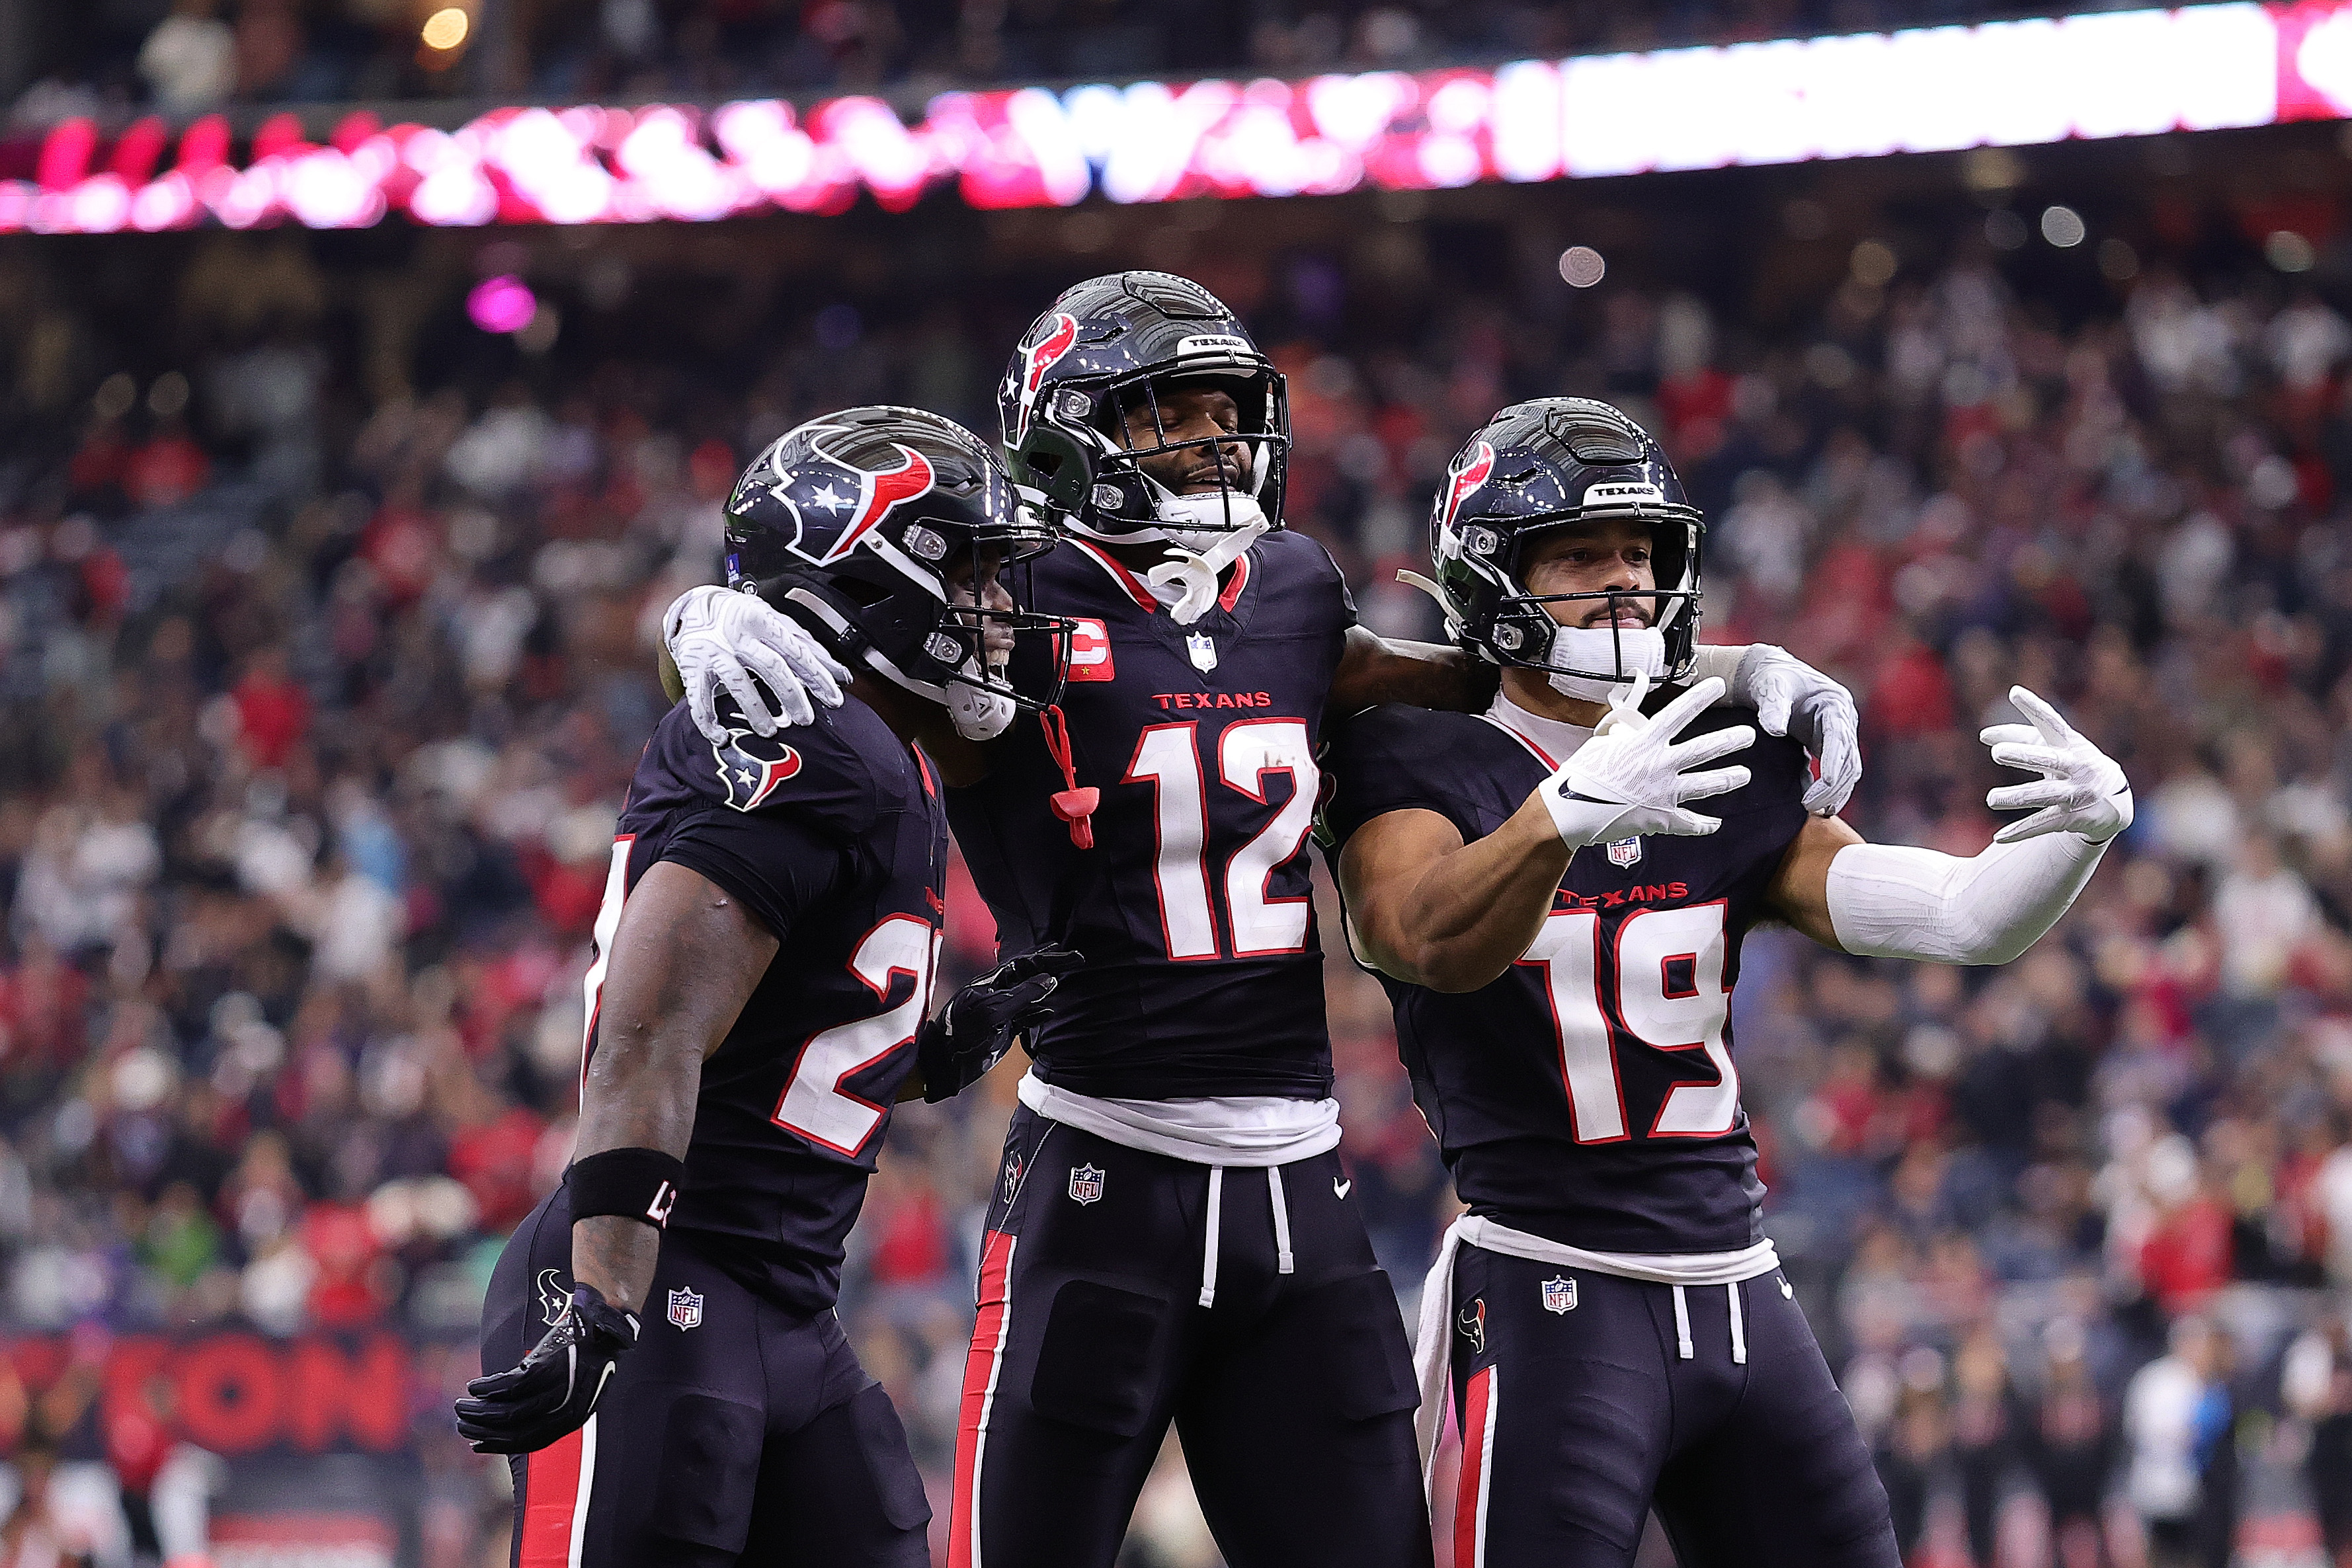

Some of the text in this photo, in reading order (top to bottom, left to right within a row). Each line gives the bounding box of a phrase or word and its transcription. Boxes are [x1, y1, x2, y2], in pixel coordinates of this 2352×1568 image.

[1189, 338, 1246, 347] TEXANS
[1594, 487, 1654, 496] TEXANS
[1151, 691, 1272, 709] TEXANS
[1119, 717, 1321, 961] 12
[1613, 846, 1636, 861] NFL
[1557, 881, 1689, 908] TEXANS
[1512, 897, 1740, 1145] 19
[1074, 1181, 1098, 1198] NFL
[1548, 1293, 1572, 1308] NFL
[673, 1305, 697, 1323] NFL
